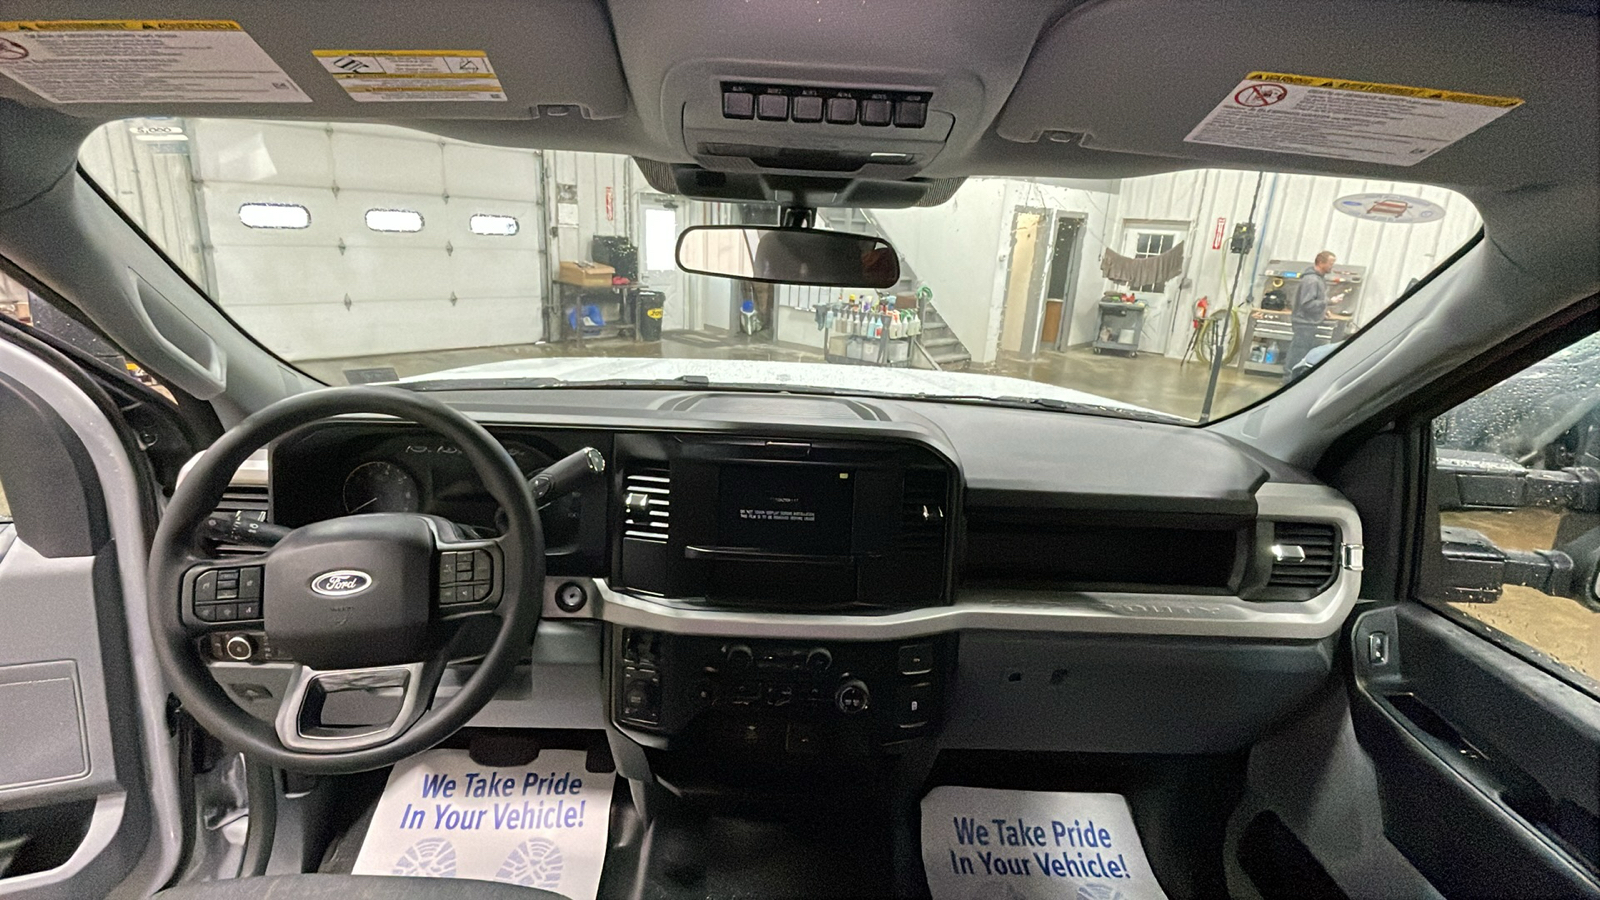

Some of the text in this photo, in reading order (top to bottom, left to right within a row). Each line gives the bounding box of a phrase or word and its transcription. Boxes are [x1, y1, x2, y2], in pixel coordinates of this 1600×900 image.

[326, 575, 357, 590] Ford
[421, 772, 582, 799] We Take Pride
[399, 800, 586, 830] In Your Vehicle!
[953, 816, 1111, 848] We Take Pride
[949, 849, 1131, 879] In Your Vehicle!
